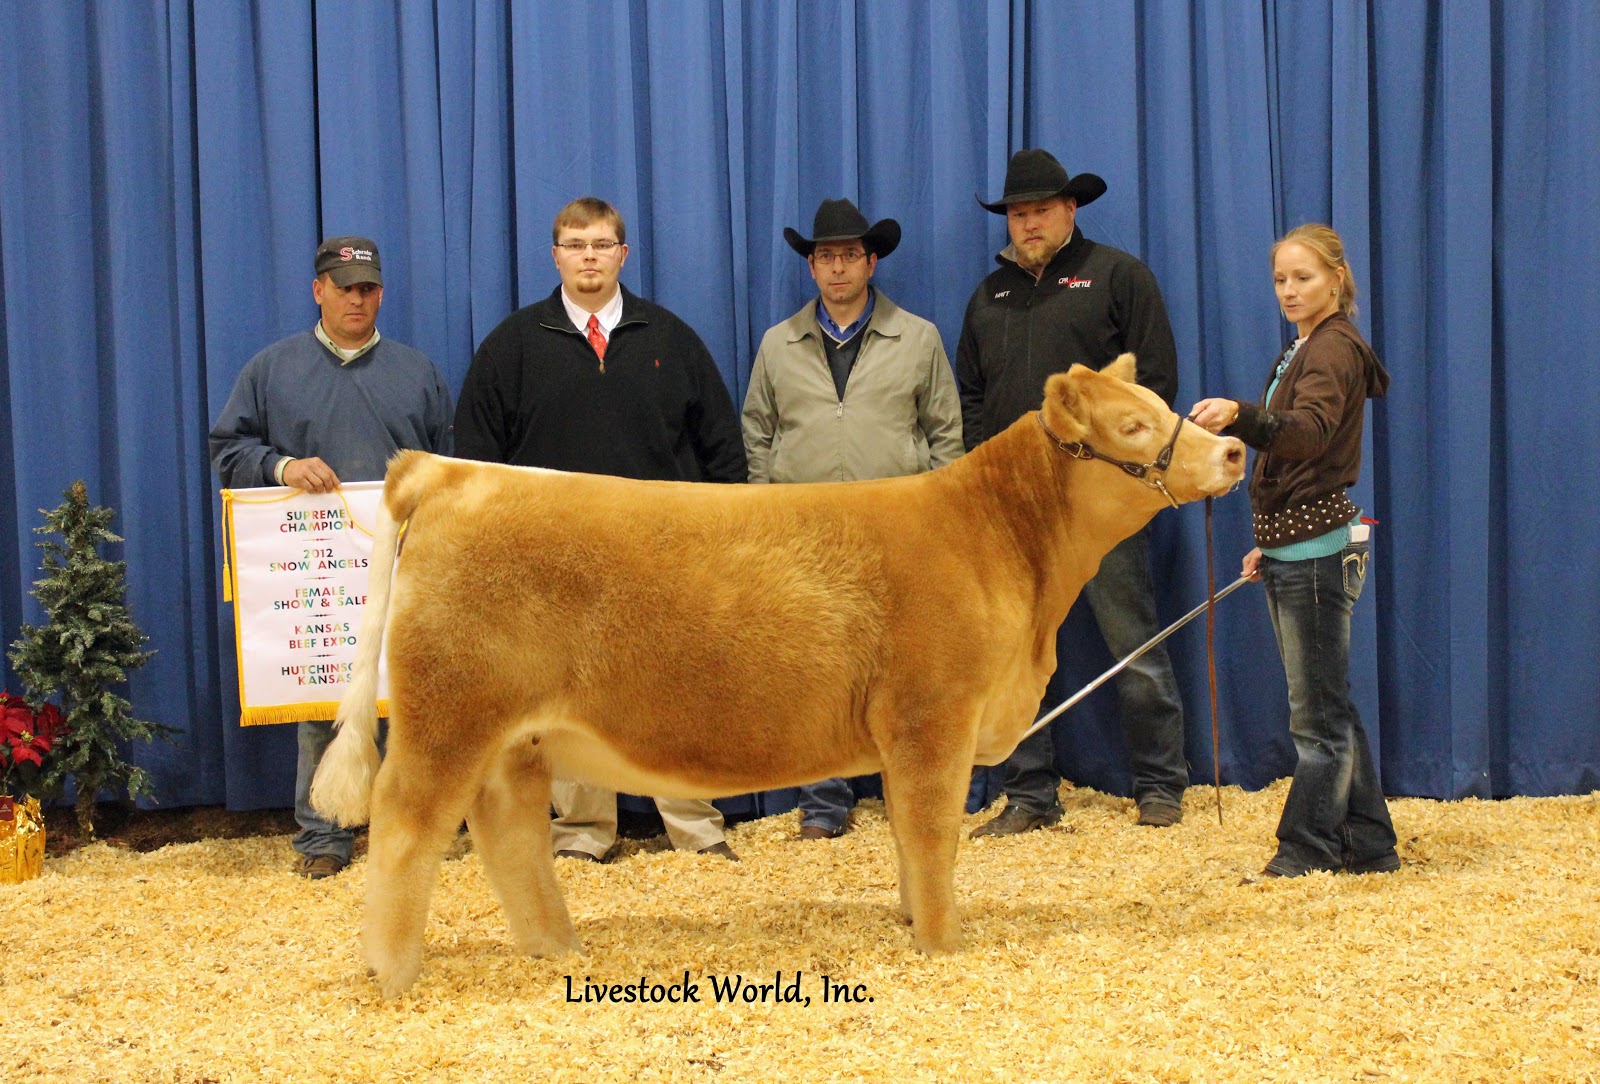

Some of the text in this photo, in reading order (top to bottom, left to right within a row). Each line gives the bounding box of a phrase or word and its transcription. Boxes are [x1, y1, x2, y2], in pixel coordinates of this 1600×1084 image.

[1069, 280, 1092, 289] CATTLE
[994, 290, 1011, 299] MATT
[286, 508, 346, 521] SUPREME
[279, 520, 354, 533] CHAMPION
[303, 548, 334, 559] 2012
[269, 558, 368, 572] SNOW ANGELS
[295, 586, 345, 598] FEMALE
[273, 595, 368, 610] SHOW & SALE
[294, 622, 350, 635] KANSAS
[289, 636, 357, 650] BEEF EXPO
[281, 662, 354, 676] HUTCHINSO
[298, 673, 352, 686] KANSAS
